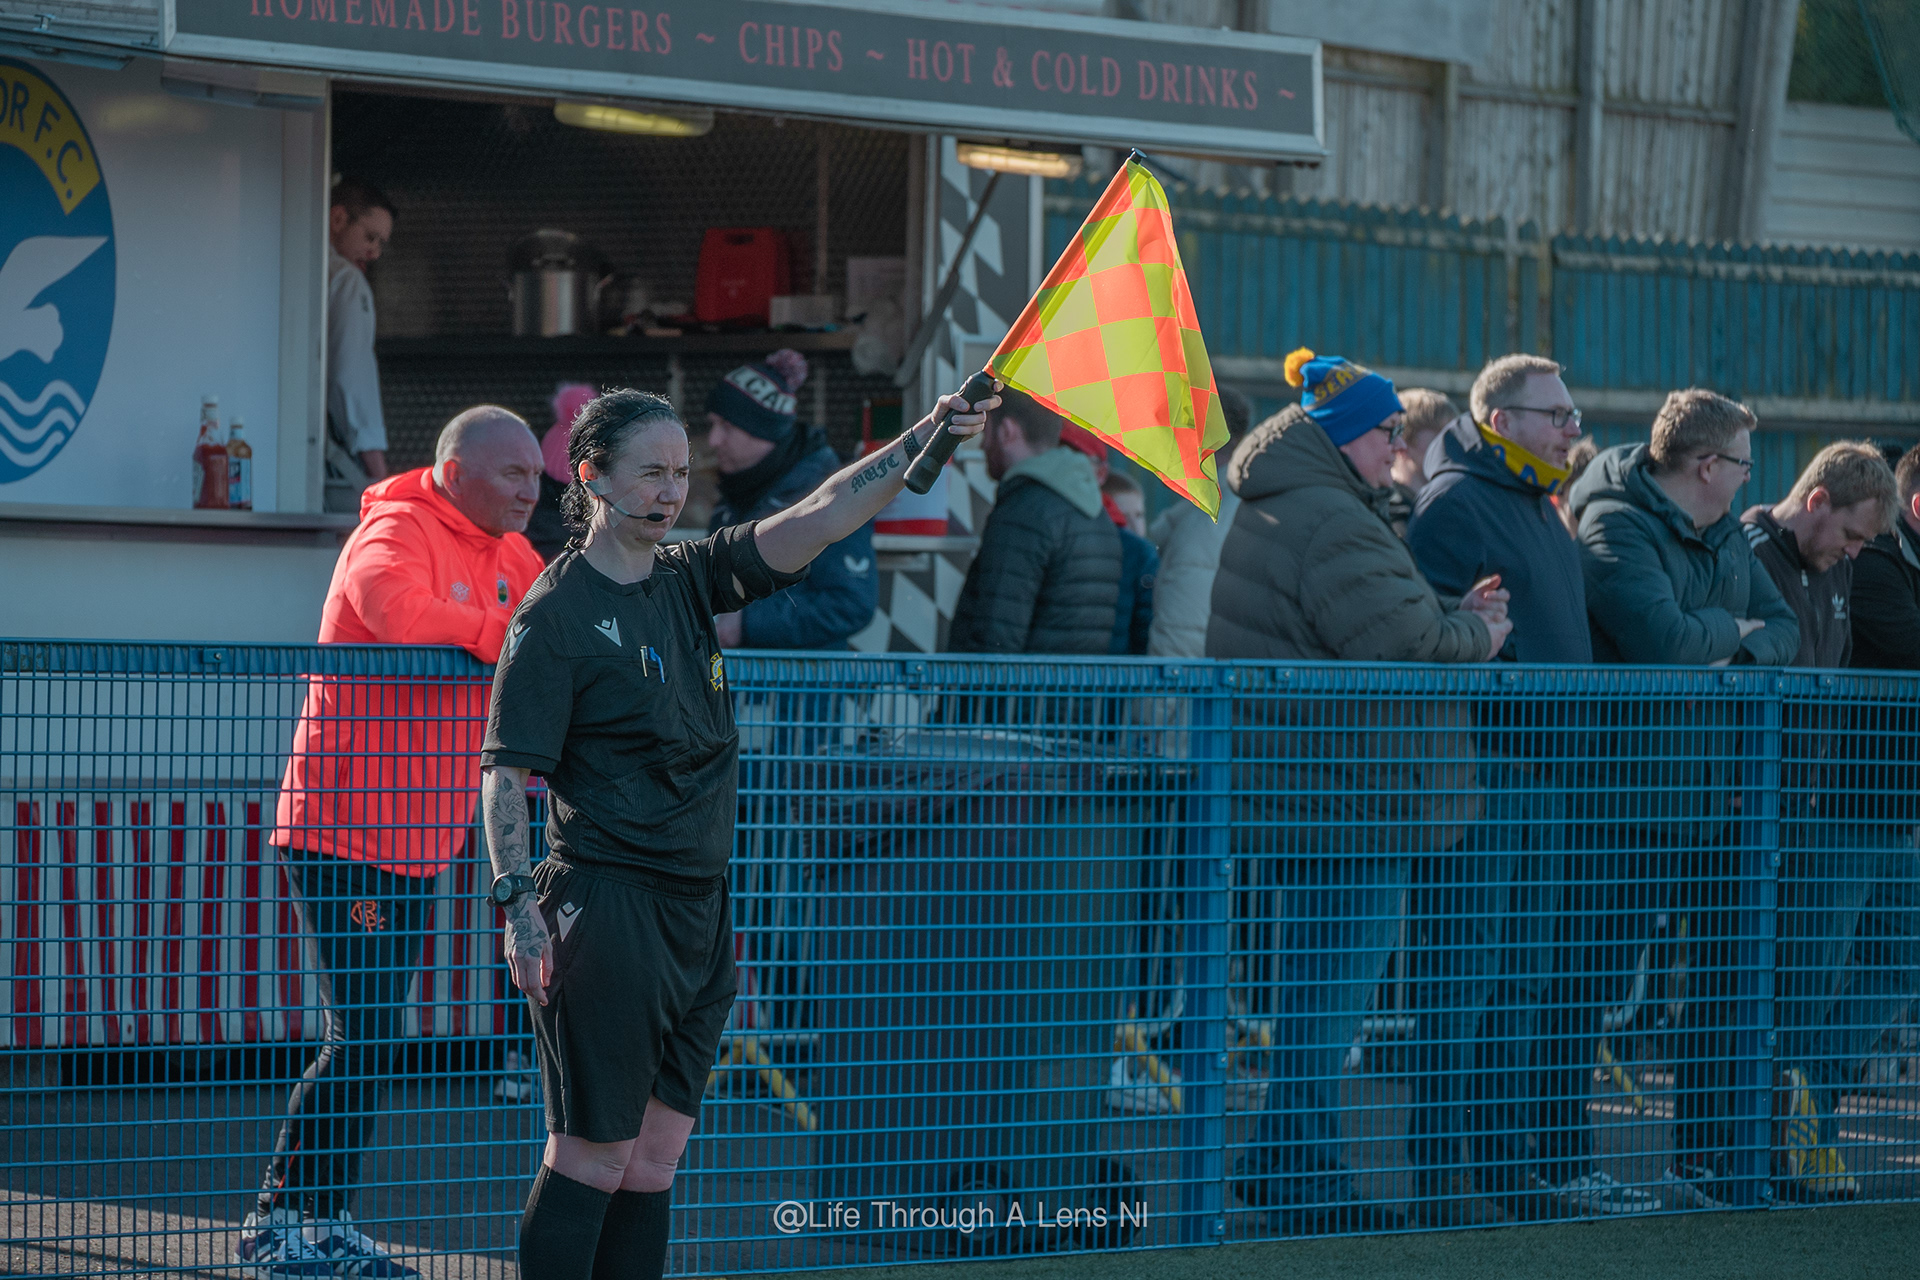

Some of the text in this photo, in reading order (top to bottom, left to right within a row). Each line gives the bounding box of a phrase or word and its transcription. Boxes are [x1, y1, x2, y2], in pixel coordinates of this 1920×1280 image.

[501, 1, 672, 55] BURGERS
[738, 21, 843, 72] CHIPS
[907, 38, 975, 84] HOT
[992, 47, 1015, 88] &
[1031, 50, 1122, 98] COLD
[1138, 60, 1258, 110] DRINKS
[33, 101, 84, 200] F.C.
[851, 453, 900, 494] MUFC
